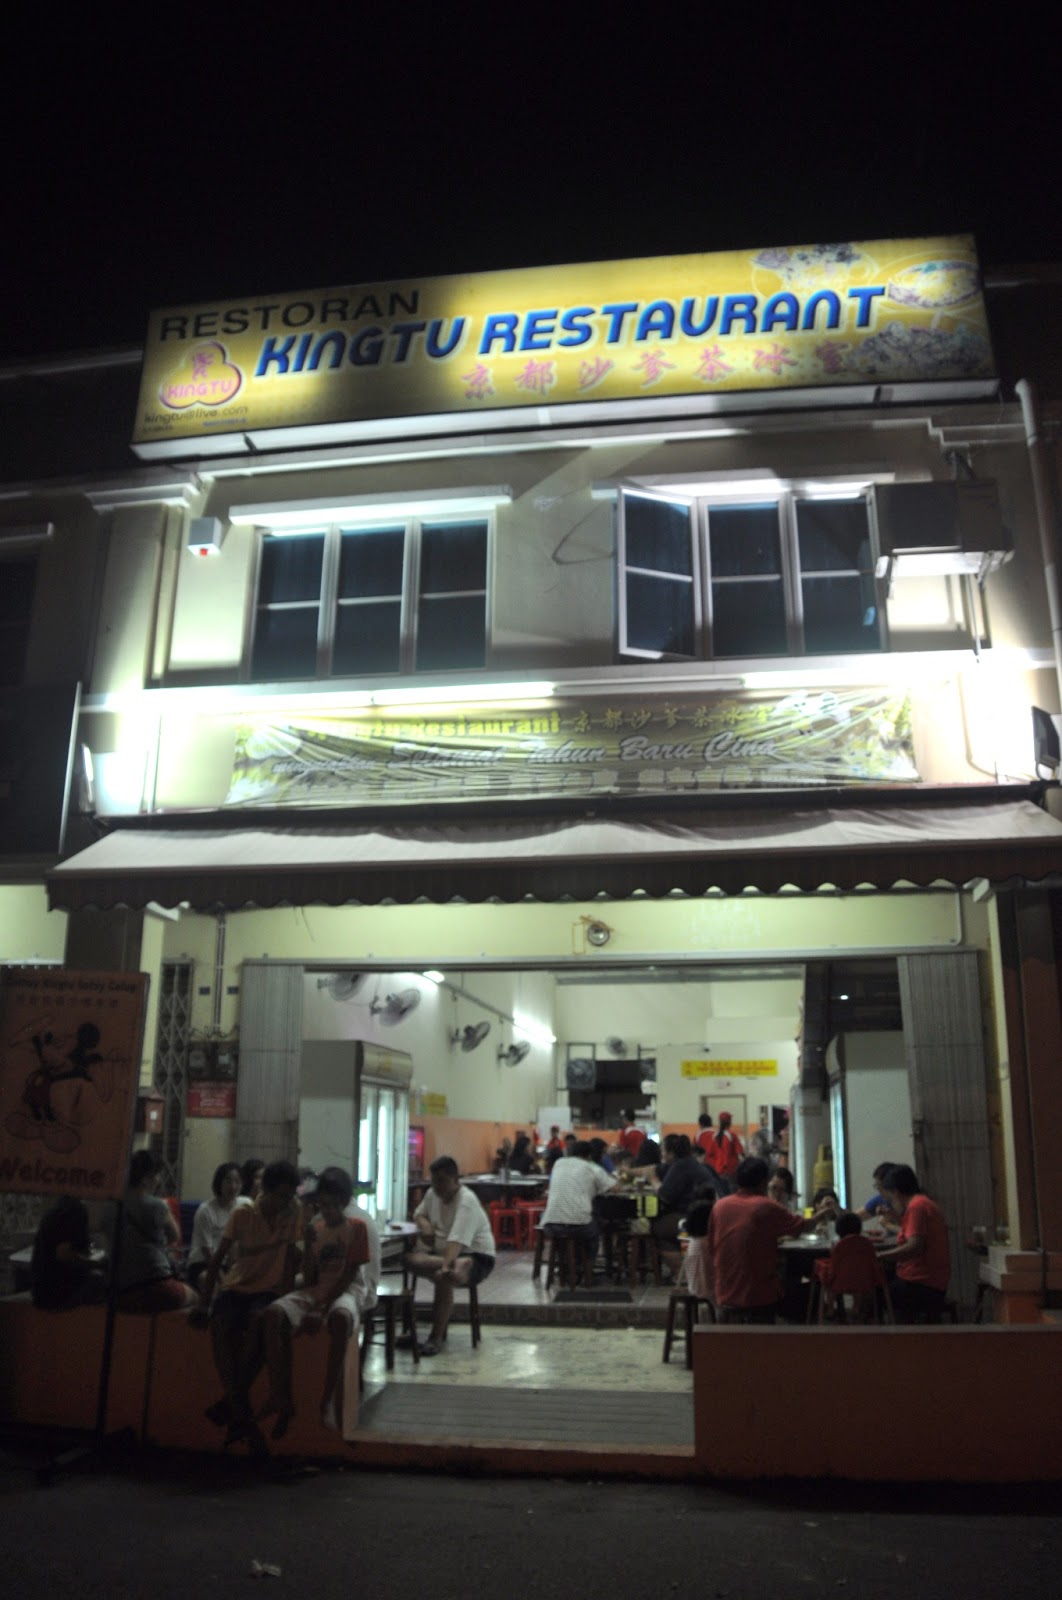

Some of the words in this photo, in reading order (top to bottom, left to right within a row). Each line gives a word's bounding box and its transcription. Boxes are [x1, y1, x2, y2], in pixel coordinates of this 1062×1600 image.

[159, 289, 421, 343] RESTORAN
[254, 316, 465, 378] KINGTU
[478, 286, 886, 355] RESTAURANT
[167, 378, 233, 399] KINGTU
[619, 735, 694, 762] Baru
[704, 730, 779, 762] Cina
[0, 1155, 106, 1189] Welcome
